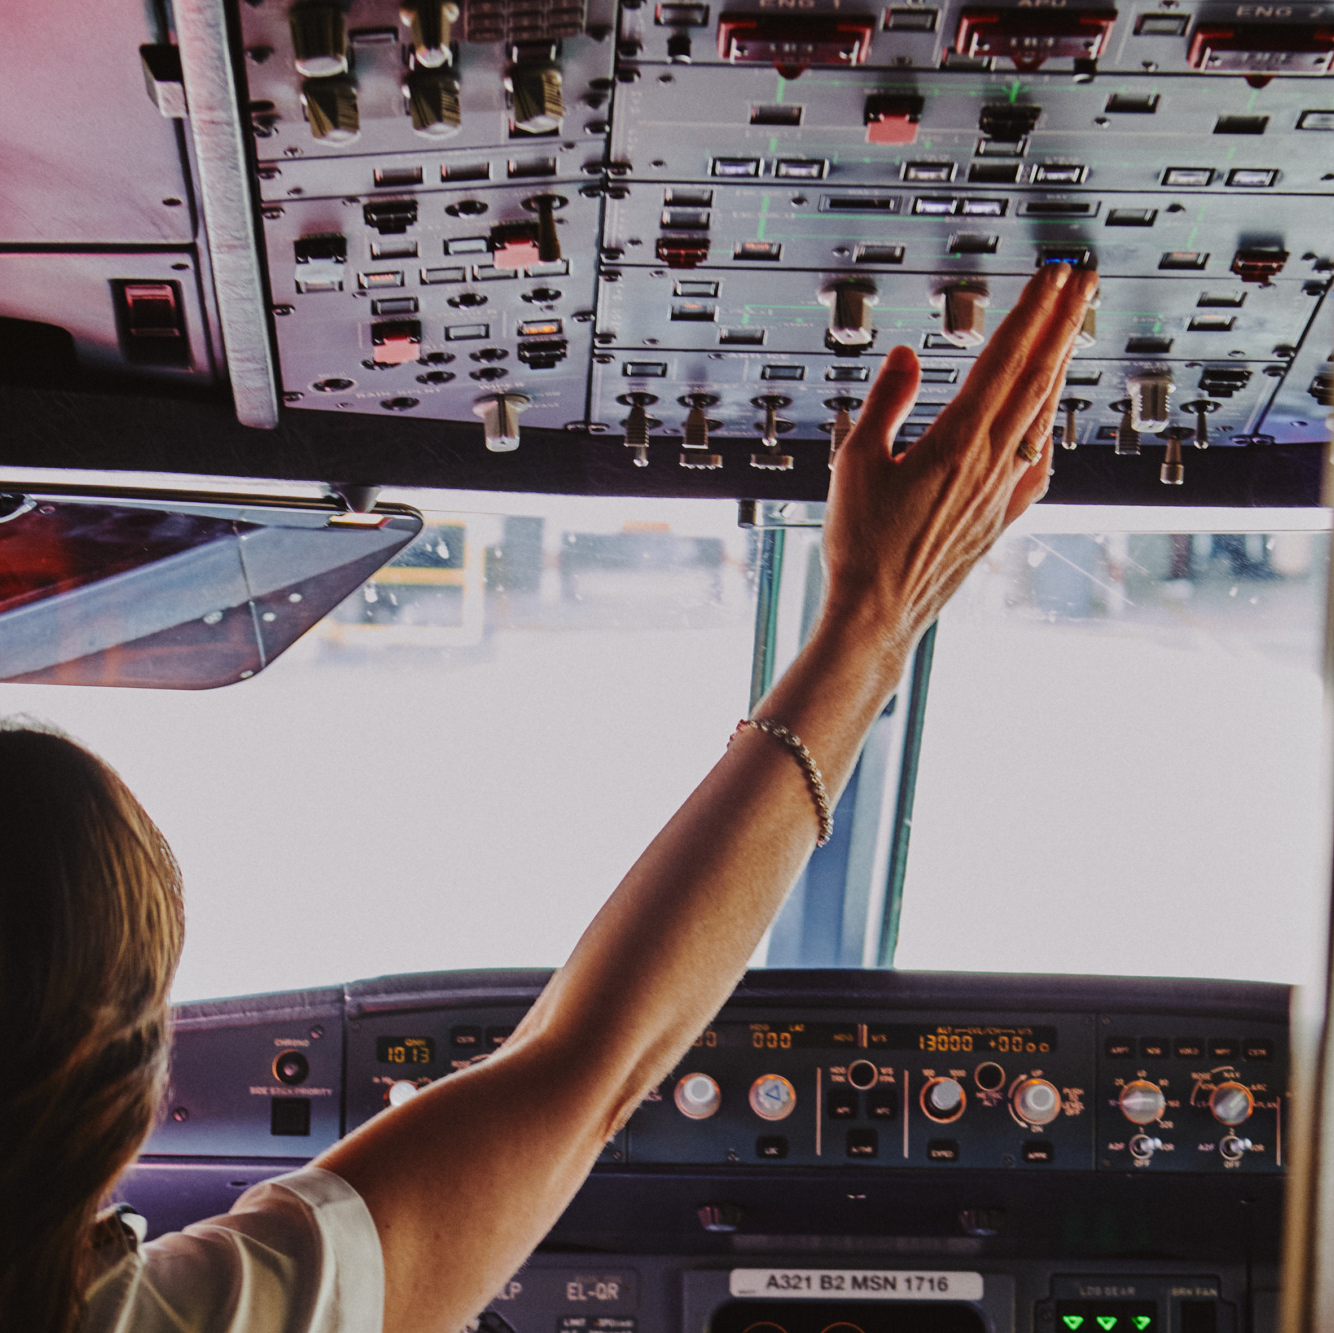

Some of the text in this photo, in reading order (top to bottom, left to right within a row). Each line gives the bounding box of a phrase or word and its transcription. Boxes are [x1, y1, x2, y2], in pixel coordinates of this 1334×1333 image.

[1236, 5, 1293, 17] ENG
[752, 1031, 792, 1049] 000
[919, 1034, 974, 1052] 13000
[387, 1046, 429, 1063] 1013
[566, 1282, 620, 1301] EL-QR
[765, 1275, 949, 1292] A321 B2 MSN 1716
